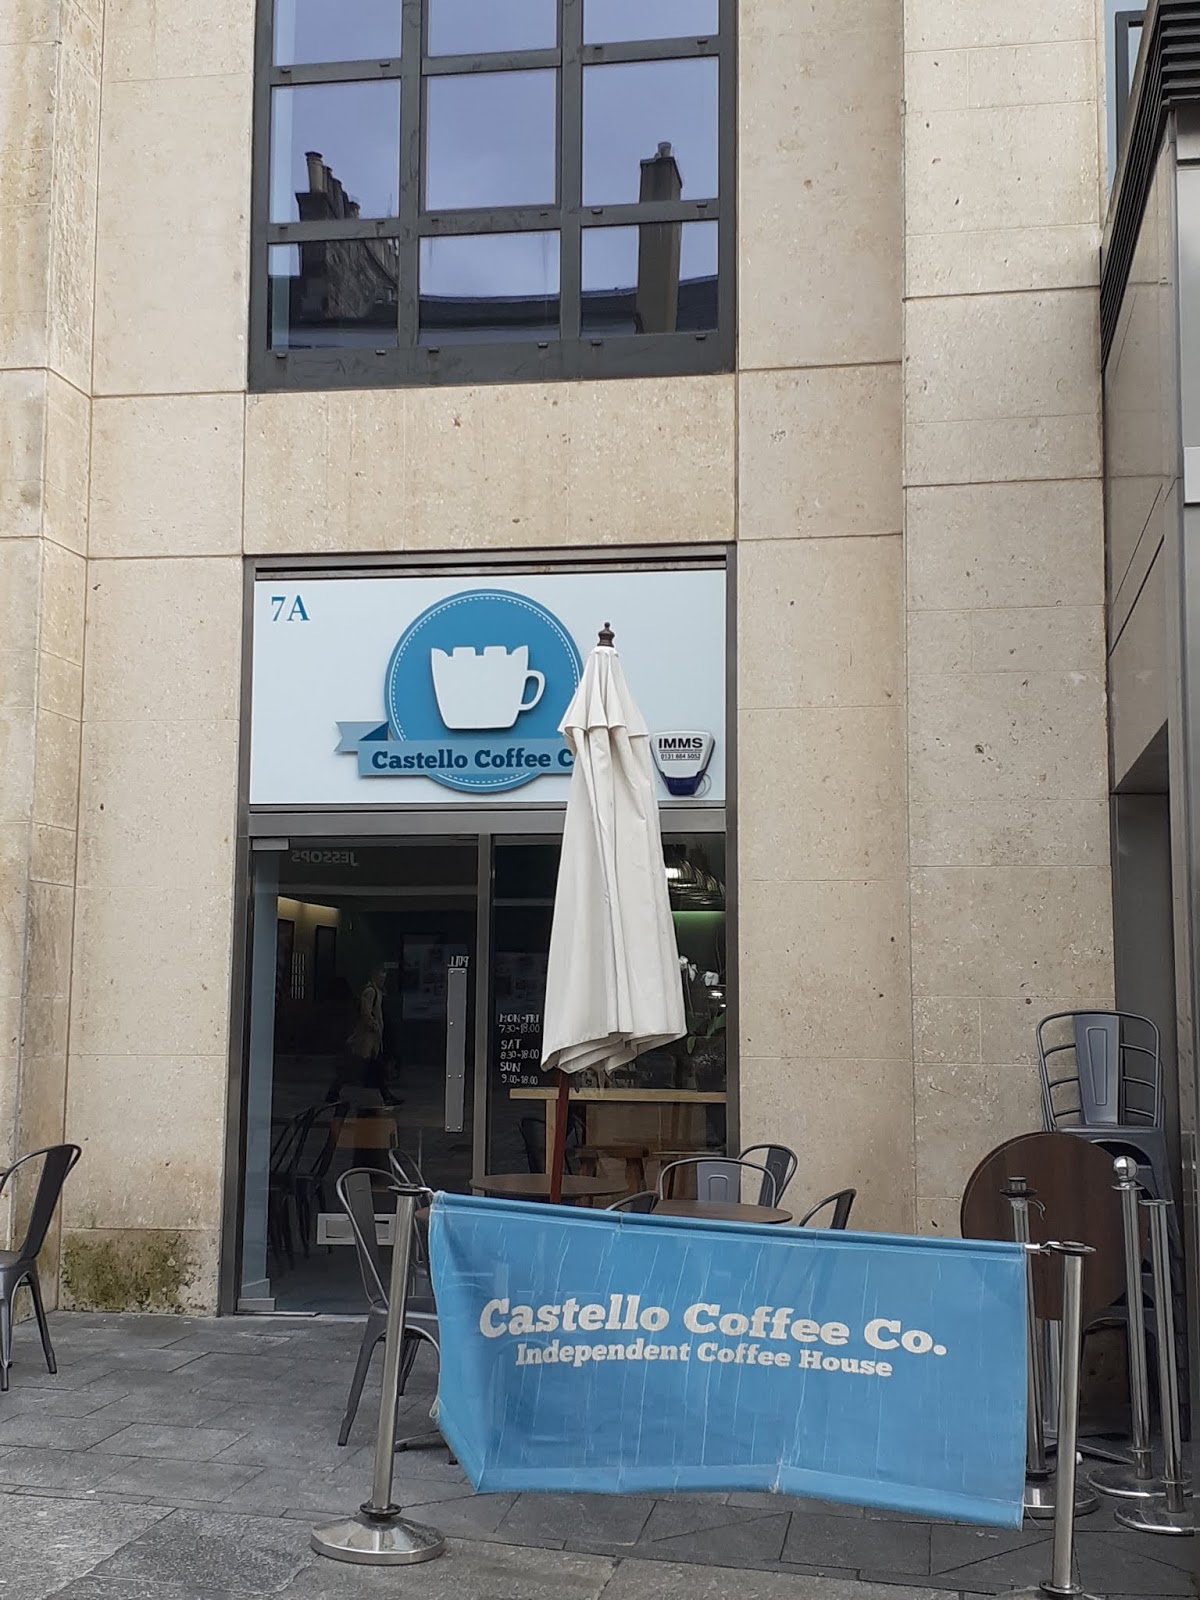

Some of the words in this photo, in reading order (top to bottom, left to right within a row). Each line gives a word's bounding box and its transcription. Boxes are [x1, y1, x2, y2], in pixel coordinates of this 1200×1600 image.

[270, 595, 310, 622] 7A
[658, 737, 703, 749] IMMS
[371, 749, 468, 769] Castello
[474, 748, 551, 769] Coffee
[557, 748, 574, 767] C
[500, 1038, 522, 1050] SAT
[499, 1061, 522, 1073] SUN
[478, 1293, 670, 1338] Castello
[683, 1302, 850, 1346] Coffee
[863, 1318, 948, 1357] Co.
[515, 1338, 690, 1368] Independent
[697, 1342, 790, 1368] Coffee
[798, 1349, 894, 1378] House
